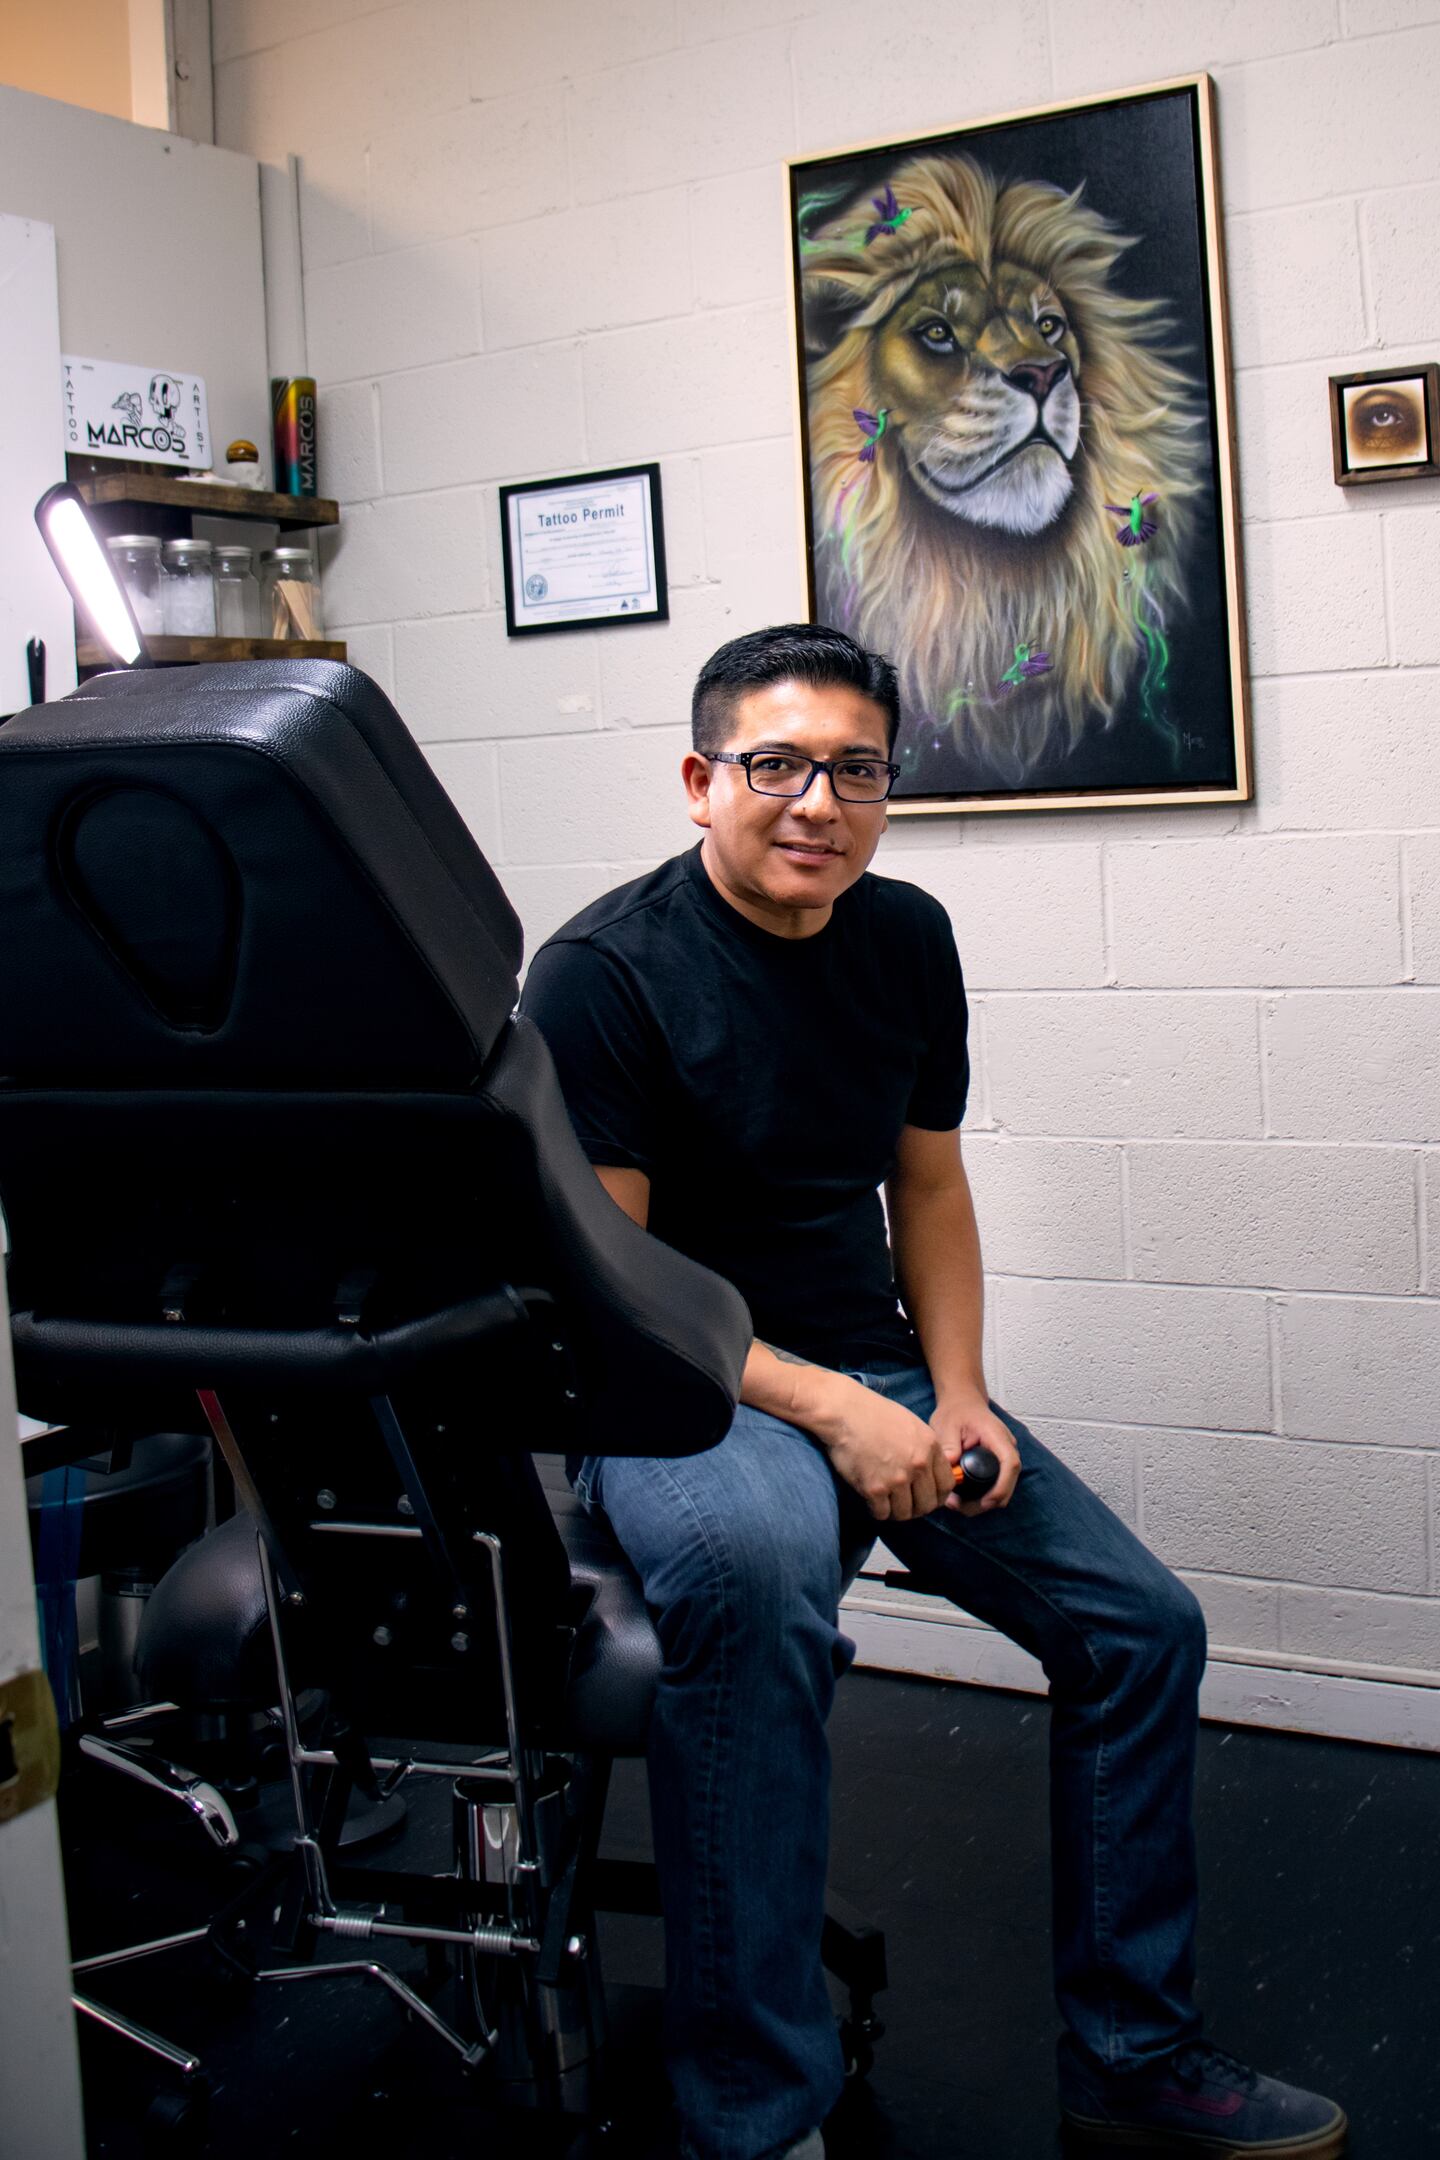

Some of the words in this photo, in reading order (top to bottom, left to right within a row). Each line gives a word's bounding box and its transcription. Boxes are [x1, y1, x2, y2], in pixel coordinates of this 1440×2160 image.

[64, 365, 78, 442] TATTOO
[87, 421, 186, 453] MARCOS
[193, 383, 205, 454] ARTIST
[300, 396, 314, 490] MARCOS
[538, 514, 577, 528] Tattoo
[583, 504, 624, 521] Permit
